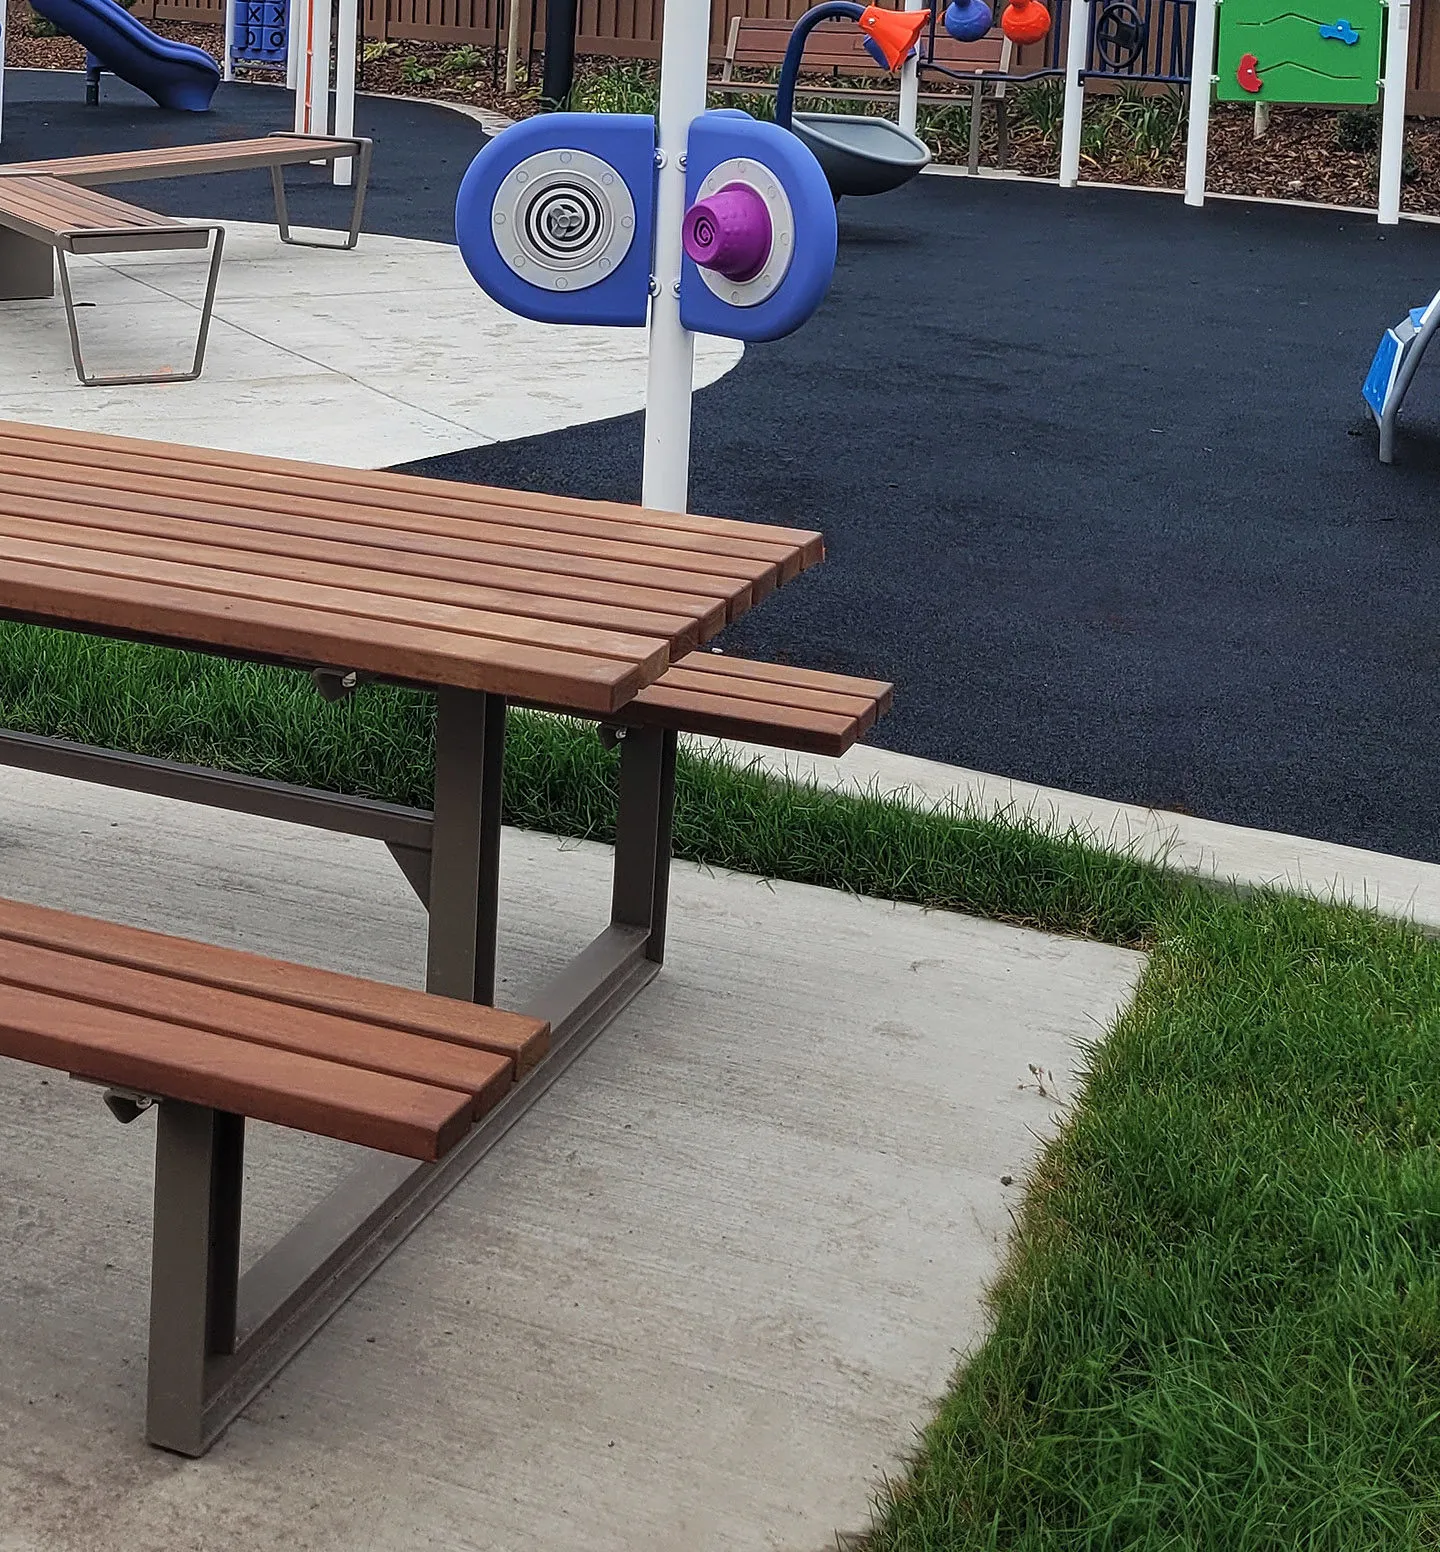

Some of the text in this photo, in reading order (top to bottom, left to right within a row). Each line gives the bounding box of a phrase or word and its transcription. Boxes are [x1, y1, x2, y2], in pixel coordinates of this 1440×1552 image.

[249, 6, 285, 25] X X
[270, 31, 284, 47] O
